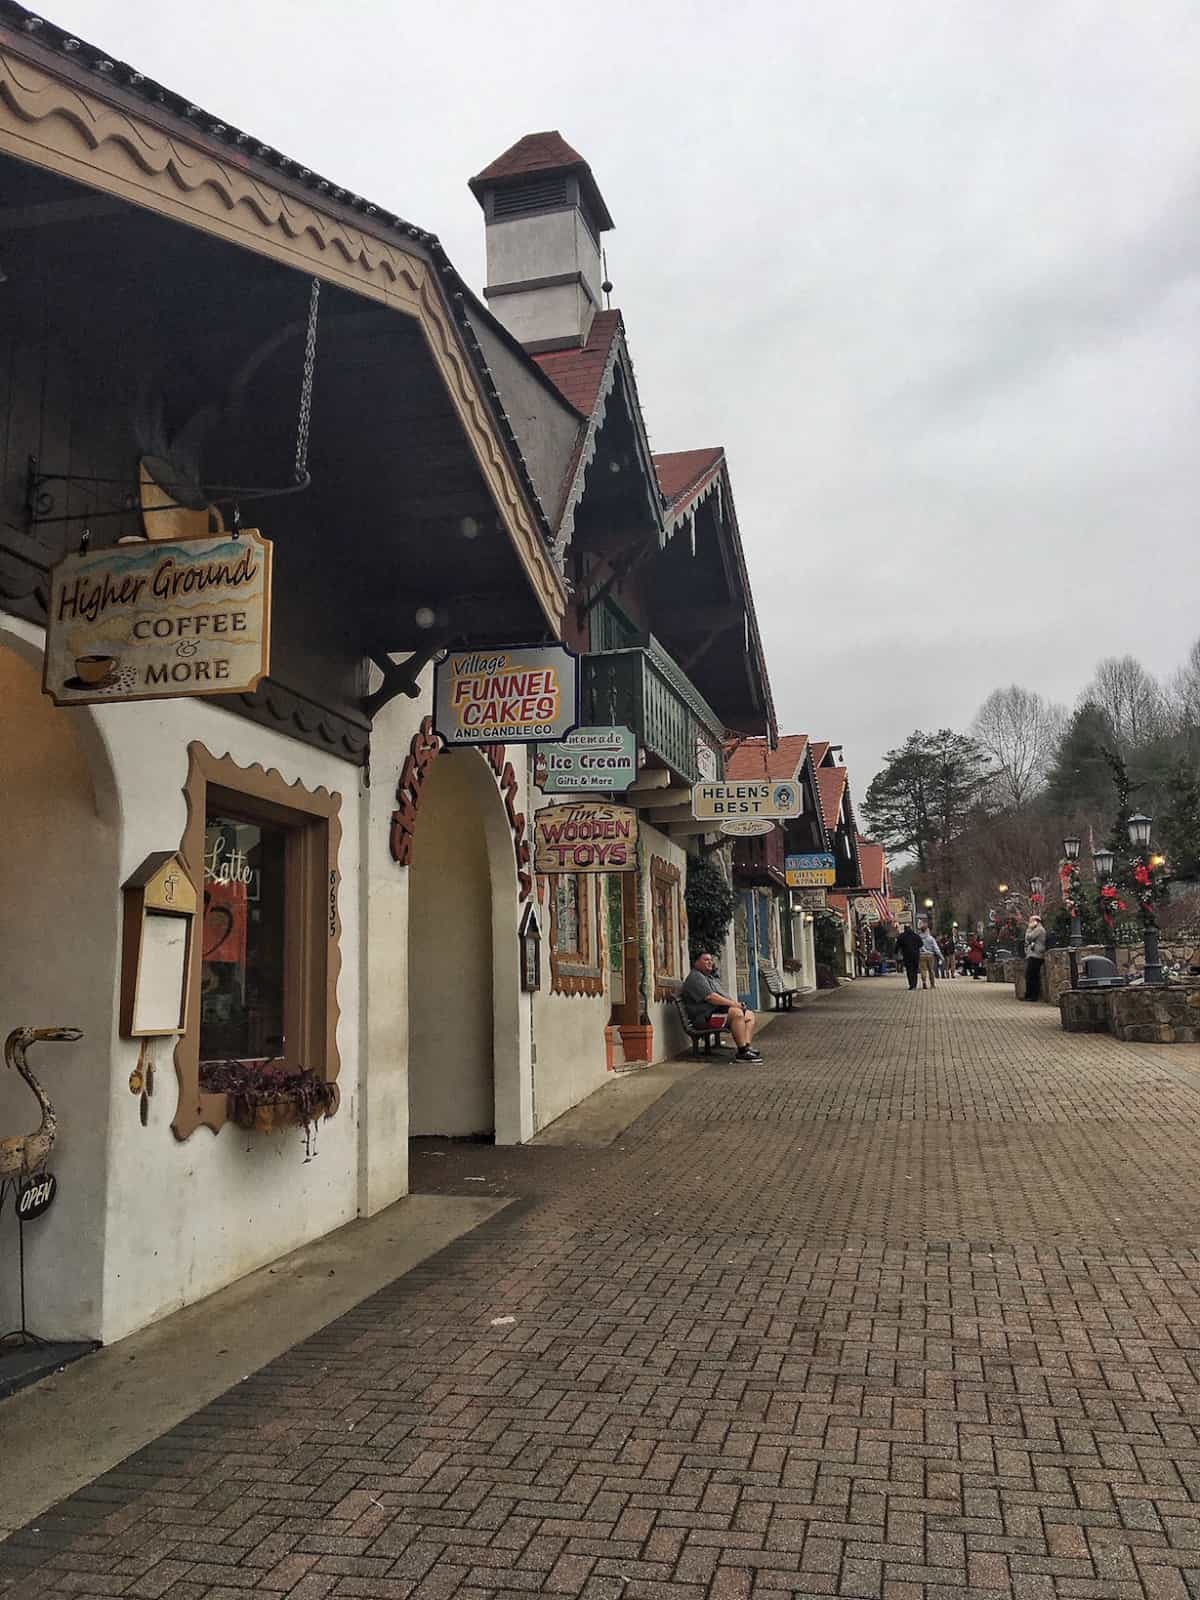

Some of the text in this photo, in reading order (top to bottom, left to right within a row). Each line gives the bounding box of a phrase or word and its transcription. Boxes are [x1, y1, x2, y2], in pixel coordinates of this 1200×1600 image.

[57, 548, 257, 622] Higher Ground
[132, 612, 247, 639] COFFEE
[175, 640, 201, 658] &
[144, 659, 231, 685] MORE
[454, 655, 506, 676] Village
[454, 671, 557, 704] FUNNEL
[462, 697, 555, 725] CAKES
[455, 724, 556, 738] AND CANDLE CO.
[550, 754, 631, 769] Ice Cream
[557, 776, 613, 785] Gifts & More
[703, 785, 769, 799] HELEN'S
[560, 805, 614, 822] Tim's
[713, 801, 762, 813] BEST
[541, 819, 630, 843] WOODEN
[204, 836, 253, 884] Latte
[546, 842, 627, 867] TOYS
[329, 870, 337, 937] 8655
[20, 1178, 54, 1212] OPEN
